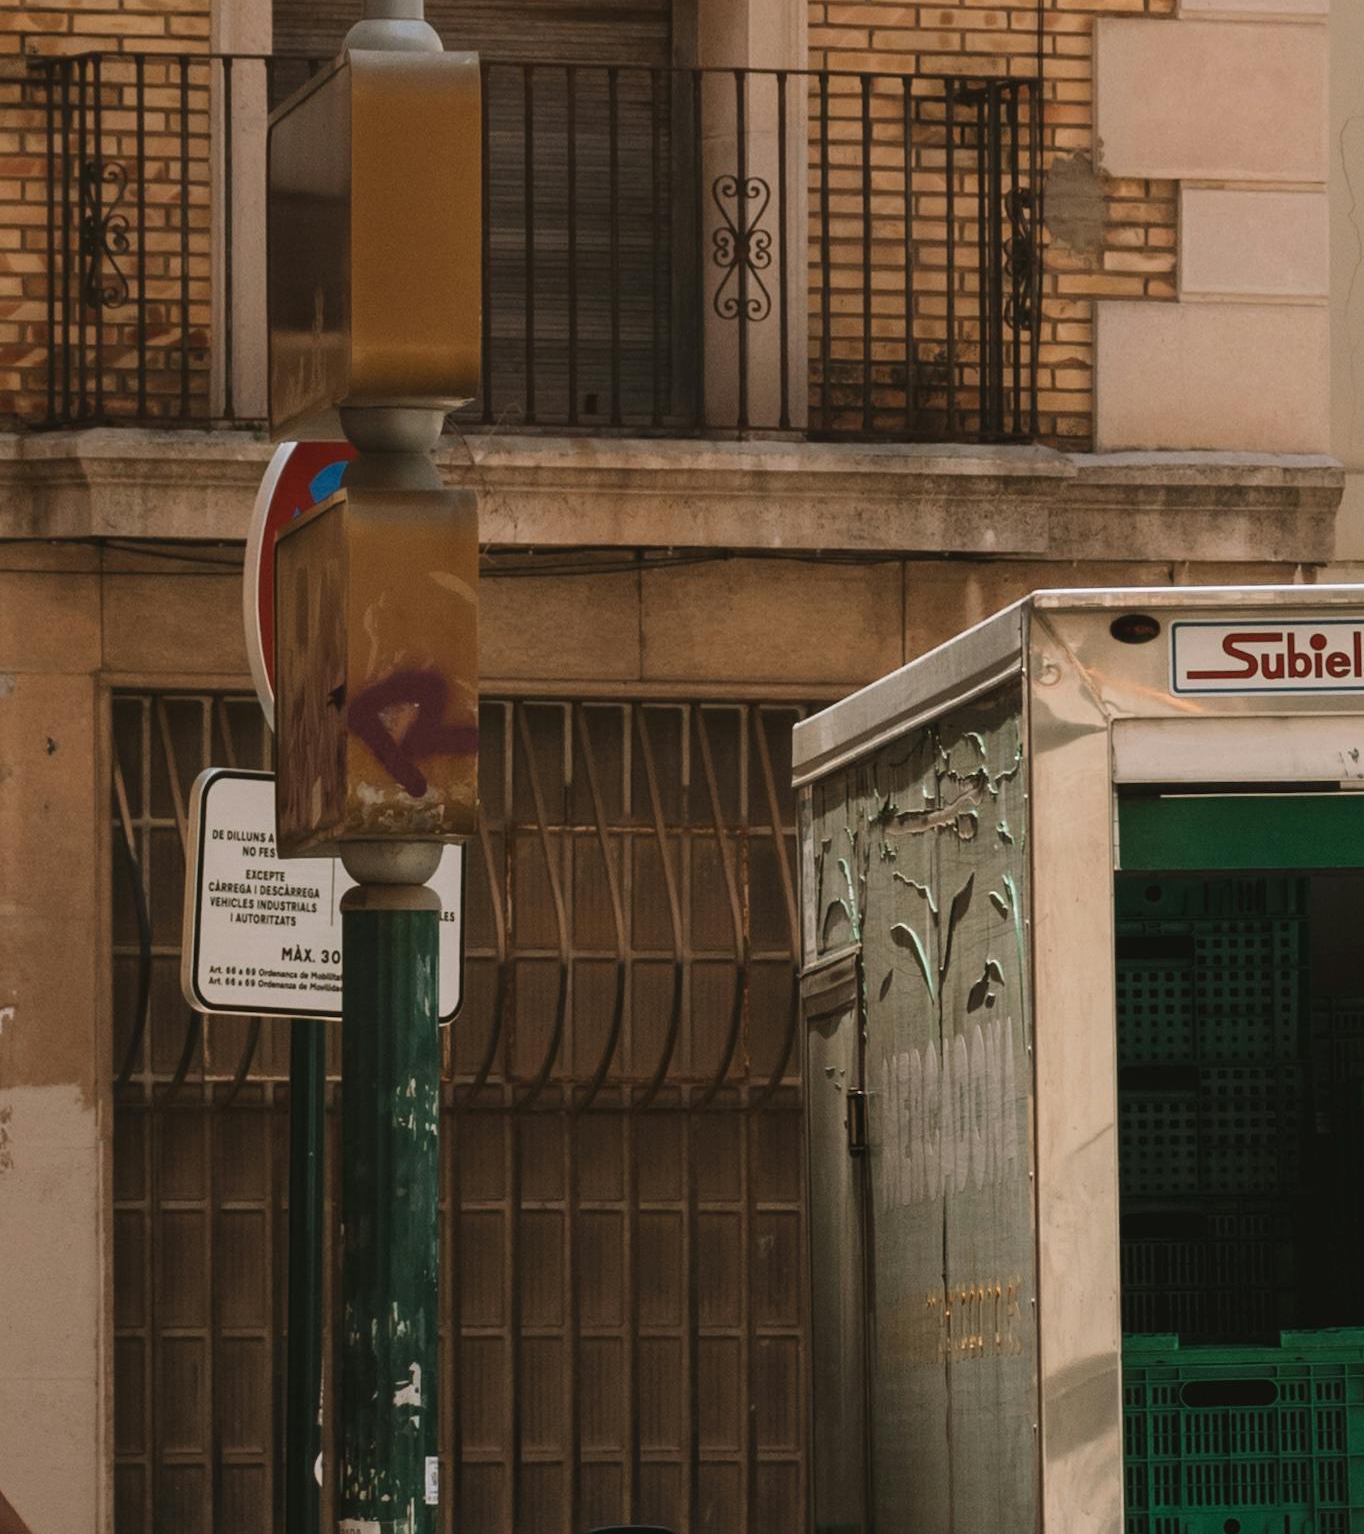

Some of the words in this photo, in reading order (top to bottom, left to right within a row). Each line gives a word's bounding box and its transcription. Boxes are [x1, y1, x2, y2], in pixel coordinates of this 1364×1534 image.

[212, 829, 224, 840] DE
[227, 830, 266, 843] DILLUNS
[268, 833, 275, 843] A
[242, 846, 257, 858] NO
[259, 847, 276, 858] FES
[245, 869, 286, 882] EXCEPTE
[208, 879, 252, 894] CÀRREGA
[254, 884, 258, 894] I
[260, 883, 320, 899] DESCÀRREGA
[210, 896, 255, 909] VEHICLES
[257, 900, 317, 913] INDUSTRIALS
[230, 913, 233, 922] I
[235, 913, 297, 927] AUTORITZATS
[439, 911, 456, 922] LES
[281, 944, 316, 963] MÀX.
[320, 950, 341, 964] 30
[209, 965, 223, 974] Art.
[299, 970, 309, 979] de
[208, 977, 222, 985] Art.
[298, 981, 308, 990] de
